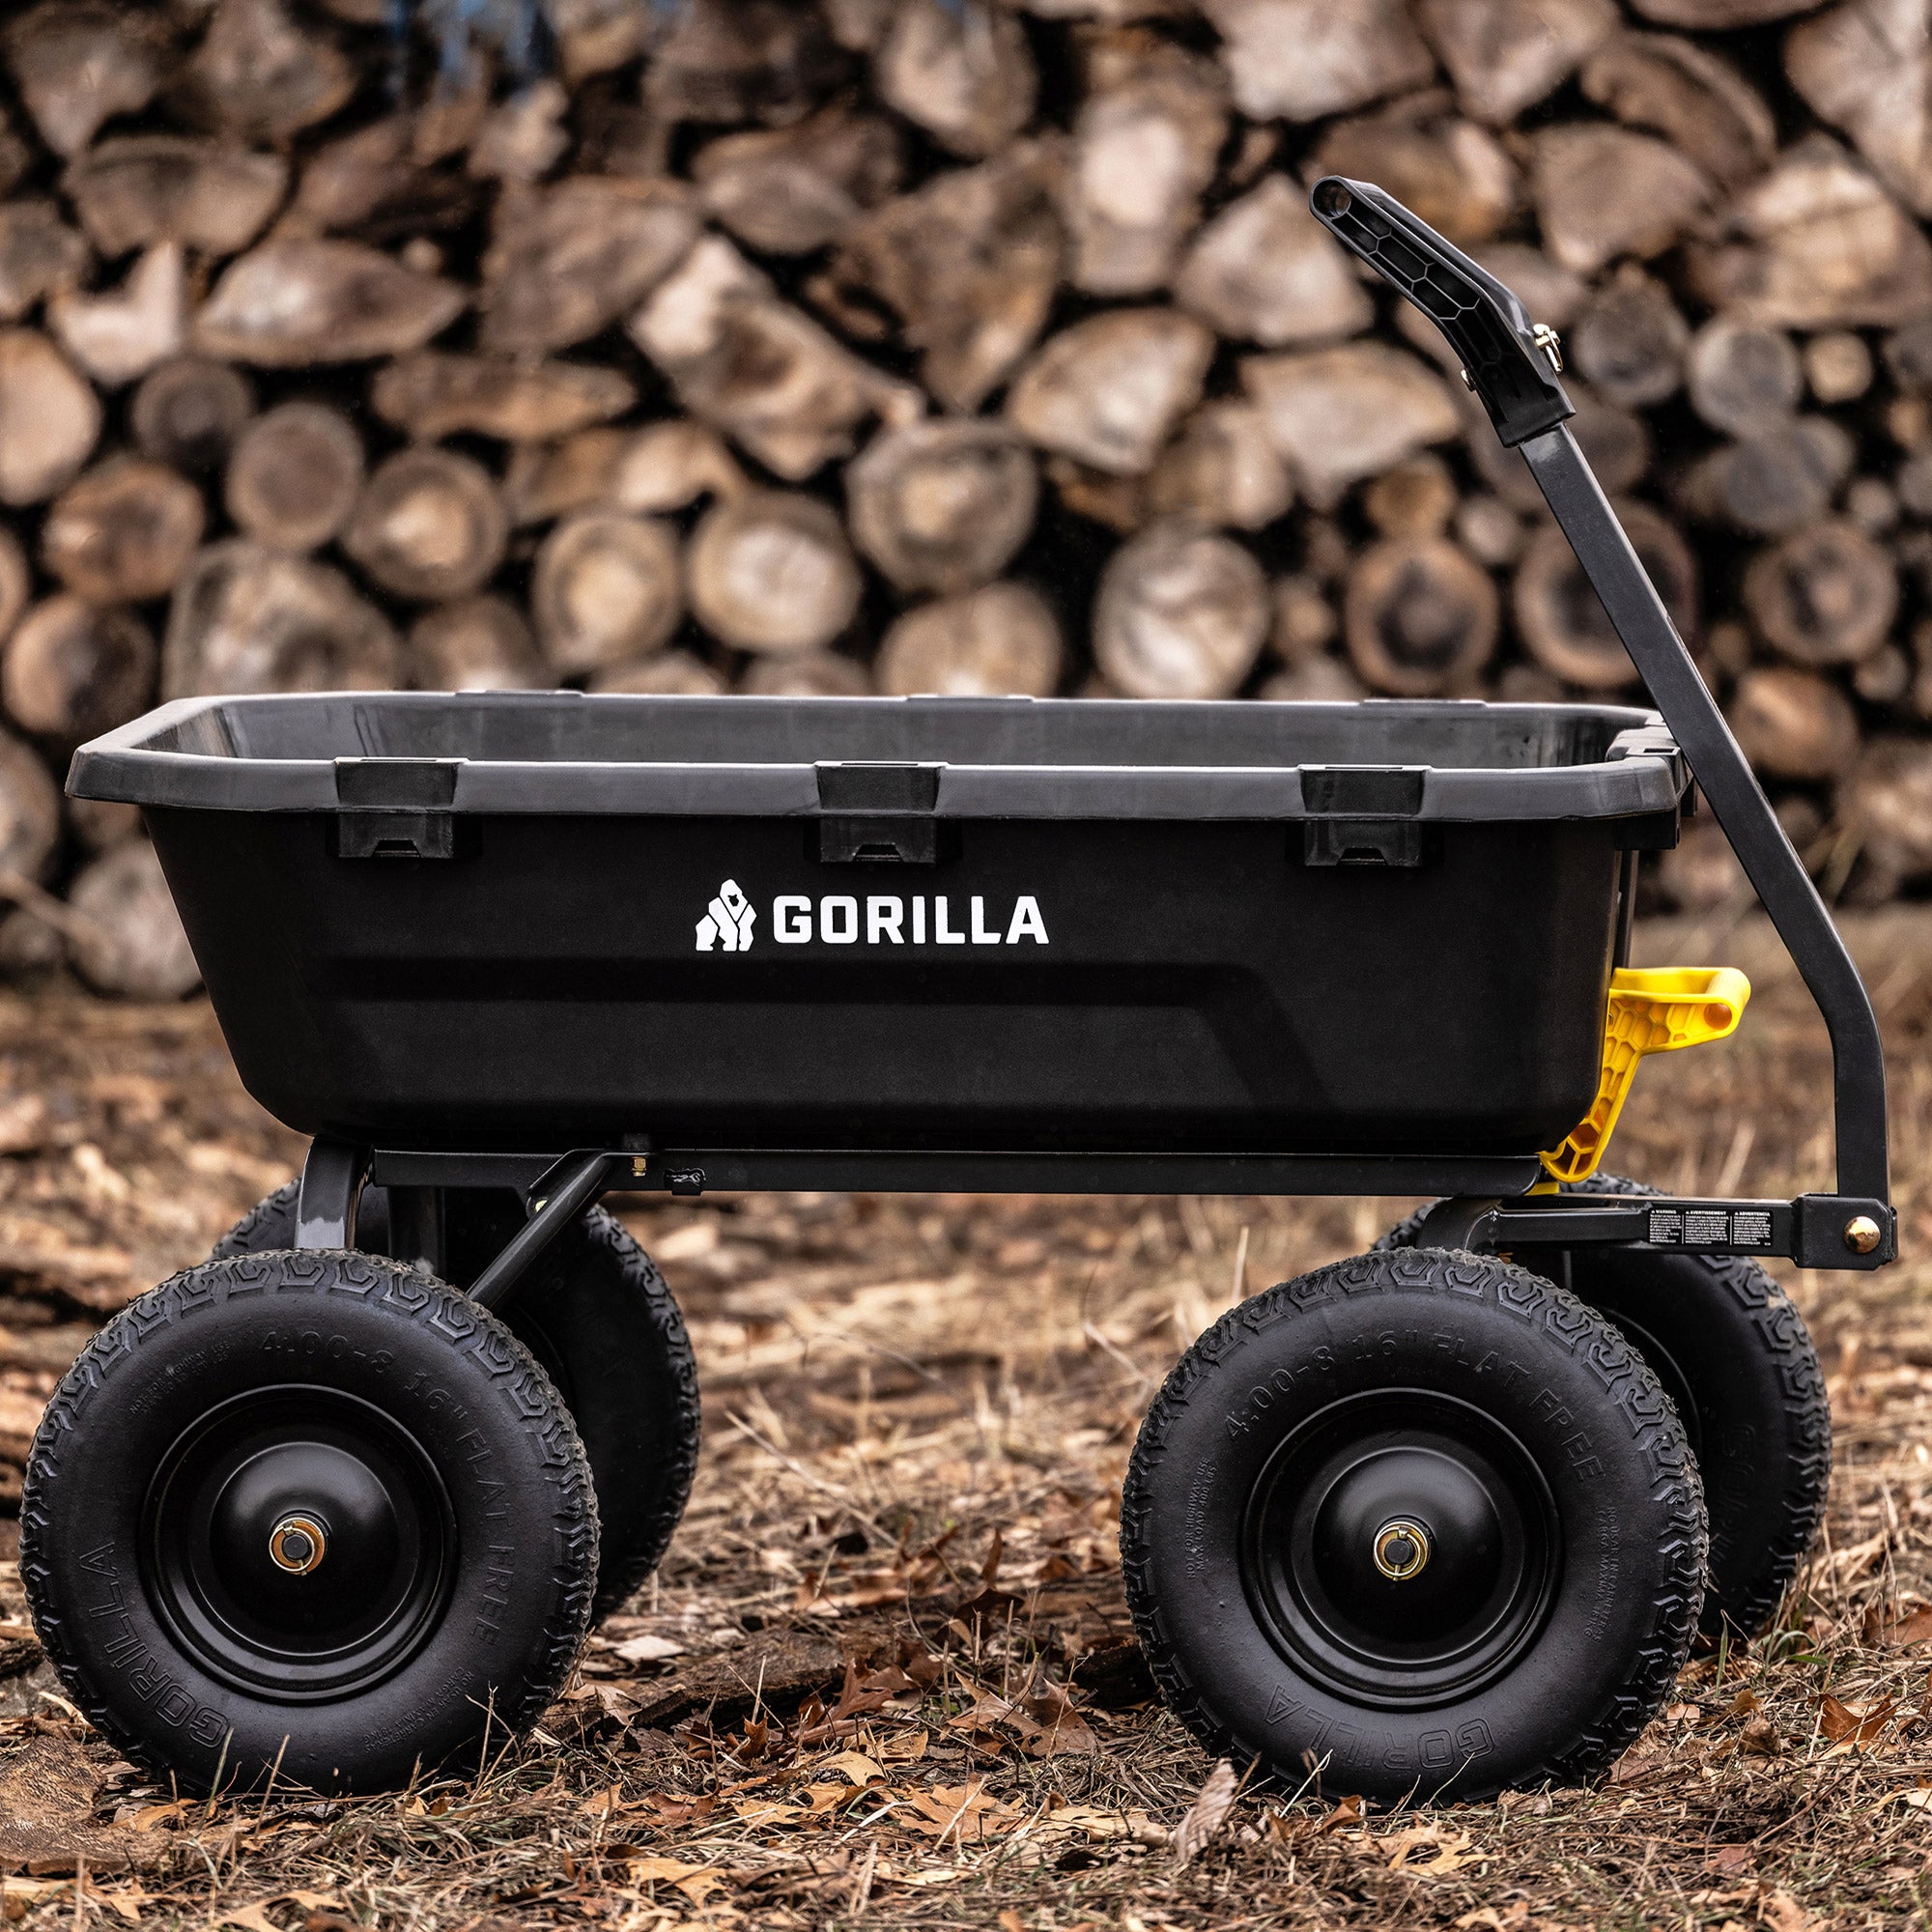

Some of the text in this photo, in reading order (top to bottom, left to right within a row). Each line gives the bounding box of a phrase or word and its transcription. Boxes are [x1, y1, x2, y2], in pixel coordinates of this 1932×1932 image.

[773, 895, 1050, 944] GORILLA
[1430, 1333, 1532, 1390] FLAT
[1528, 1388, 1605, 1481] FREE
[456, 1429, 512, 1529] FLAT
[1185, 1478, 1201, 1528] HIGHWAY
[472, 1545, 516, 1647] FREE
[78, 1542, 232, 1748] GORILLA
[363, 1718, 426, 1753] CARRETERAS
[1264, 1685, 1495, 1769] GORILLA
